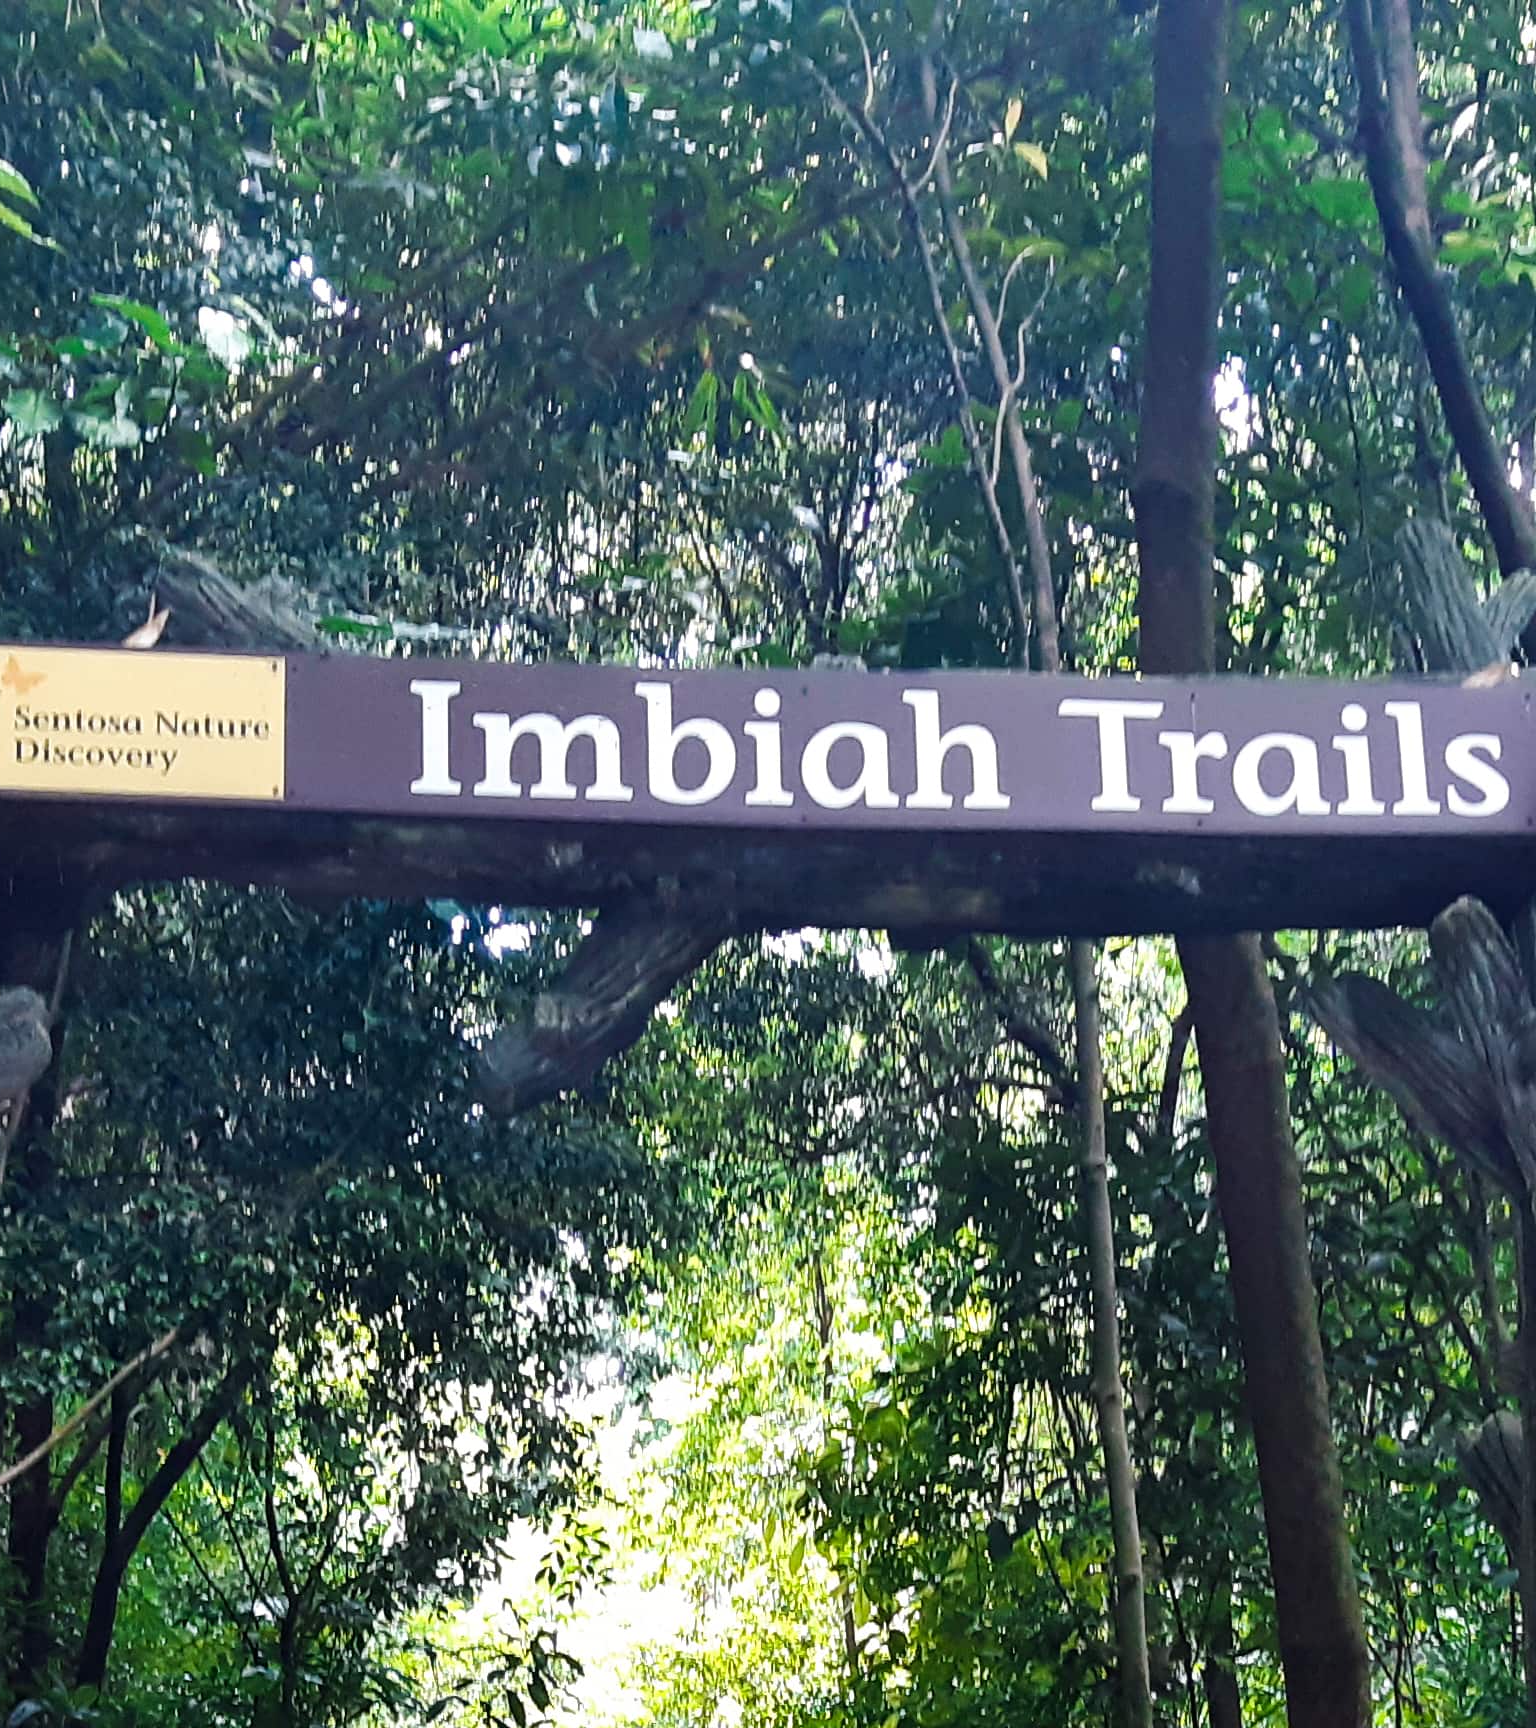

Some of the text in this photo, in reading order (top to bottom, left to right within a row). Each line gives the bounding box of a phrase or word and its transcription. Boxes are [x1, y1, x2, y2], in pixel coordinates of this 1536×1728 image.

[14, 704, 270, 740] Sentosa Nature
[14, 737, 178, 776] Discovery
[409, 679, 1511, 816] Imbiah Trails
